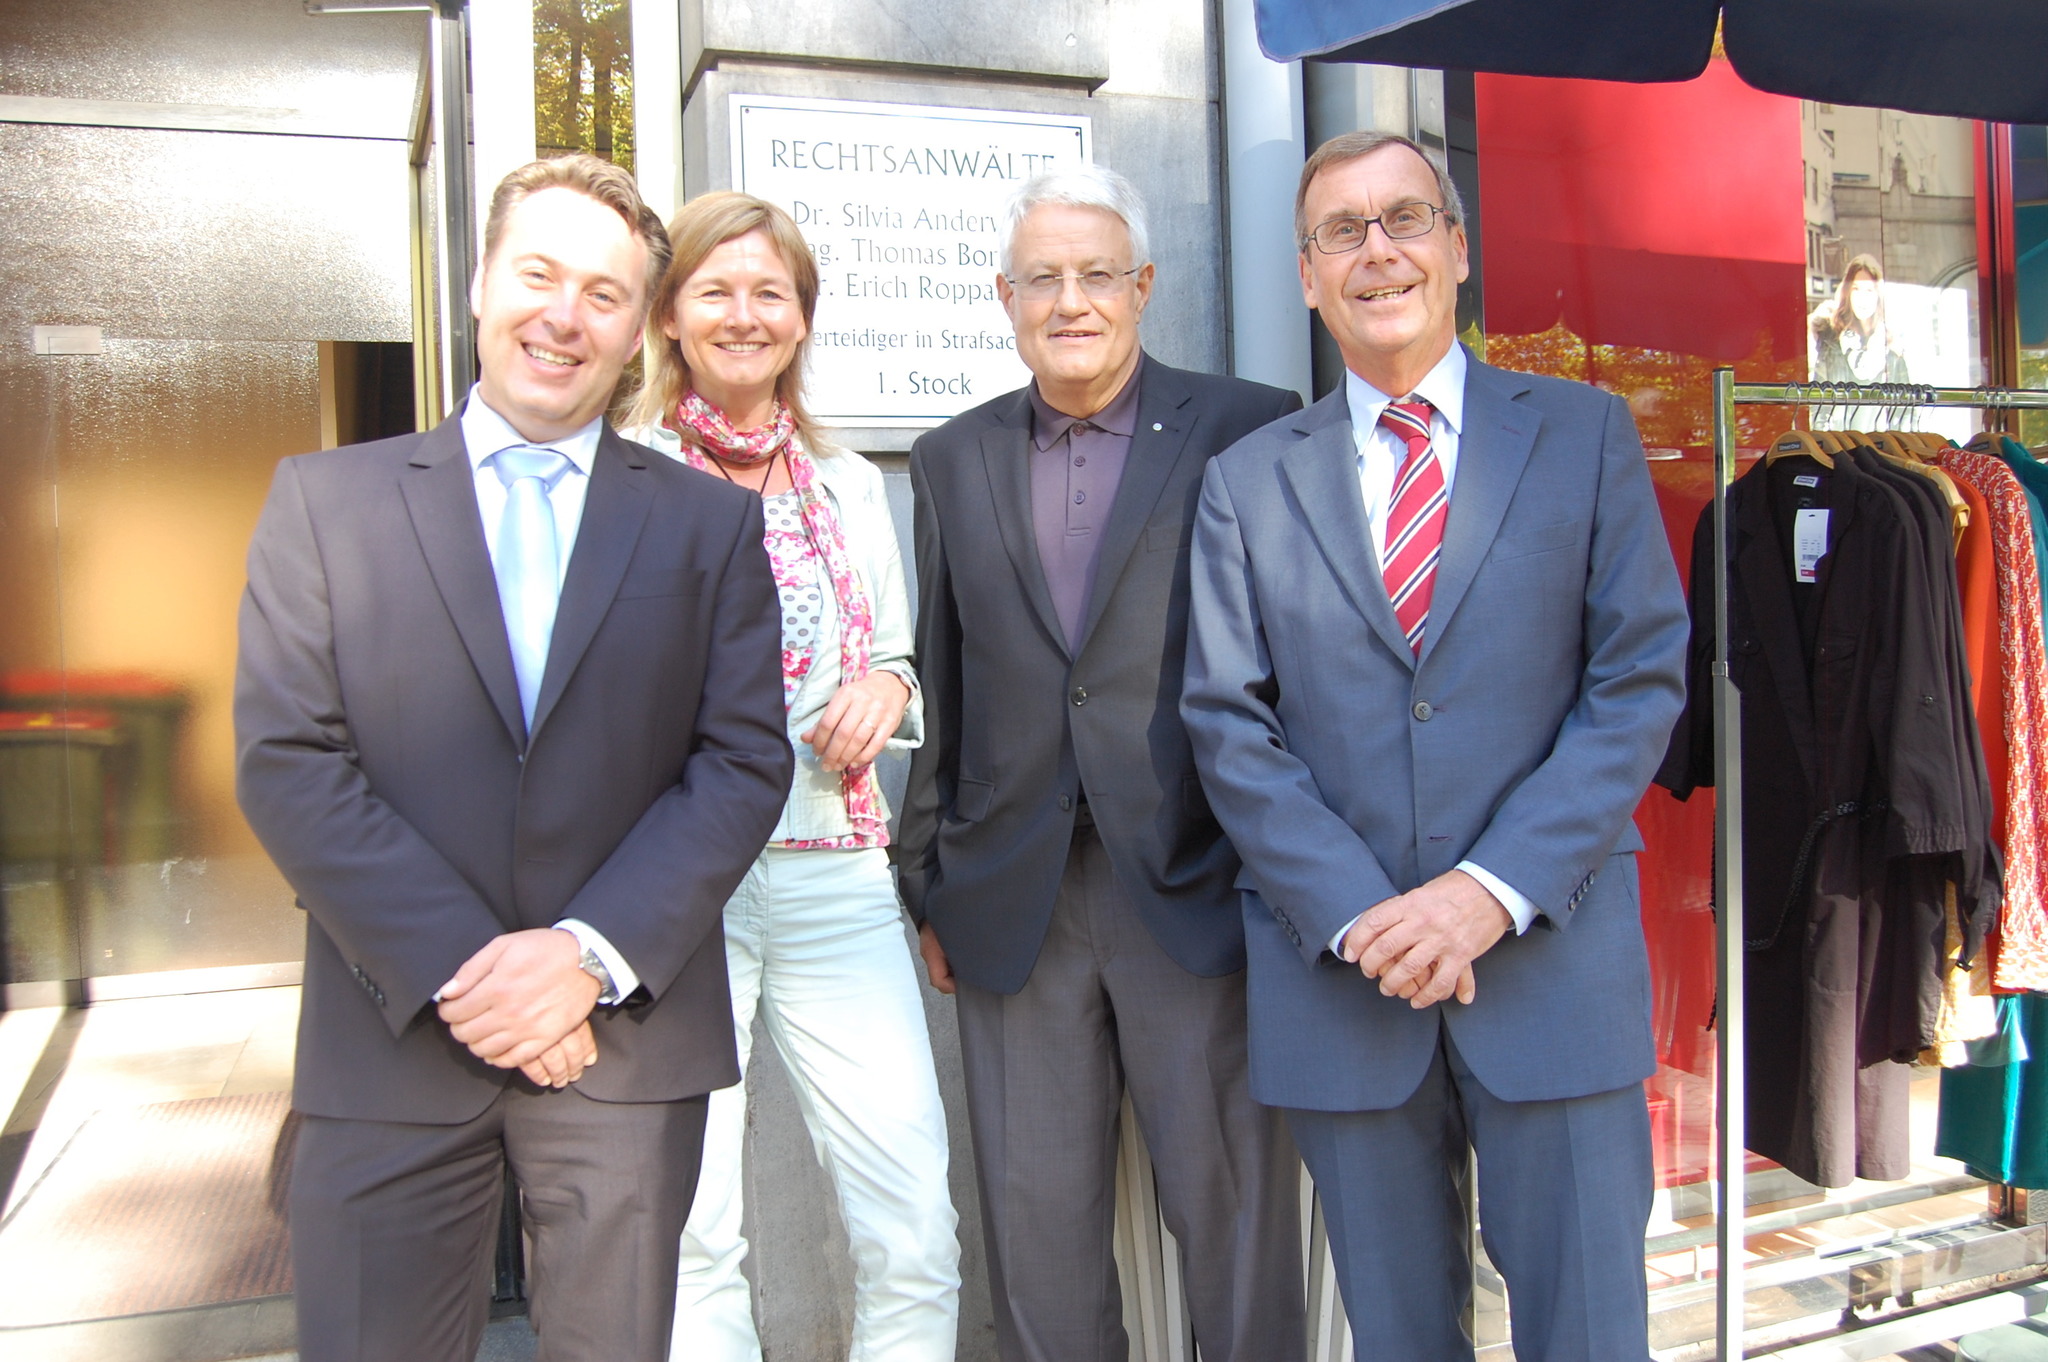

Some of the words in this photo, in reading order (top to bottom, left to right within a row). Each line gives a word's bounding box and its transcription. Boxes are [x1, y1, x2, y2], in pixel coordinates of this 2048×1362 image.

[793, 200, 830, 226] Dr.
[842, 202, 903, 229] Silvia
[807, 243, 840, 266] ag.
[850, 238, 947, 266] Thomas
[958, 242, 999, 267] Bor
[817, 278, 834, 297] r.
[846, 272, 908, 299] Erich
[919, 275, 1001, 306] Roppa
[814, 326, 910, 352] erteidiger
[915, 329, 933, 349] in
[941, 329, 1016, 351] Strafsac
[878, 371, 897, 394] 1.
[908, 371, 972, 396] Stock
